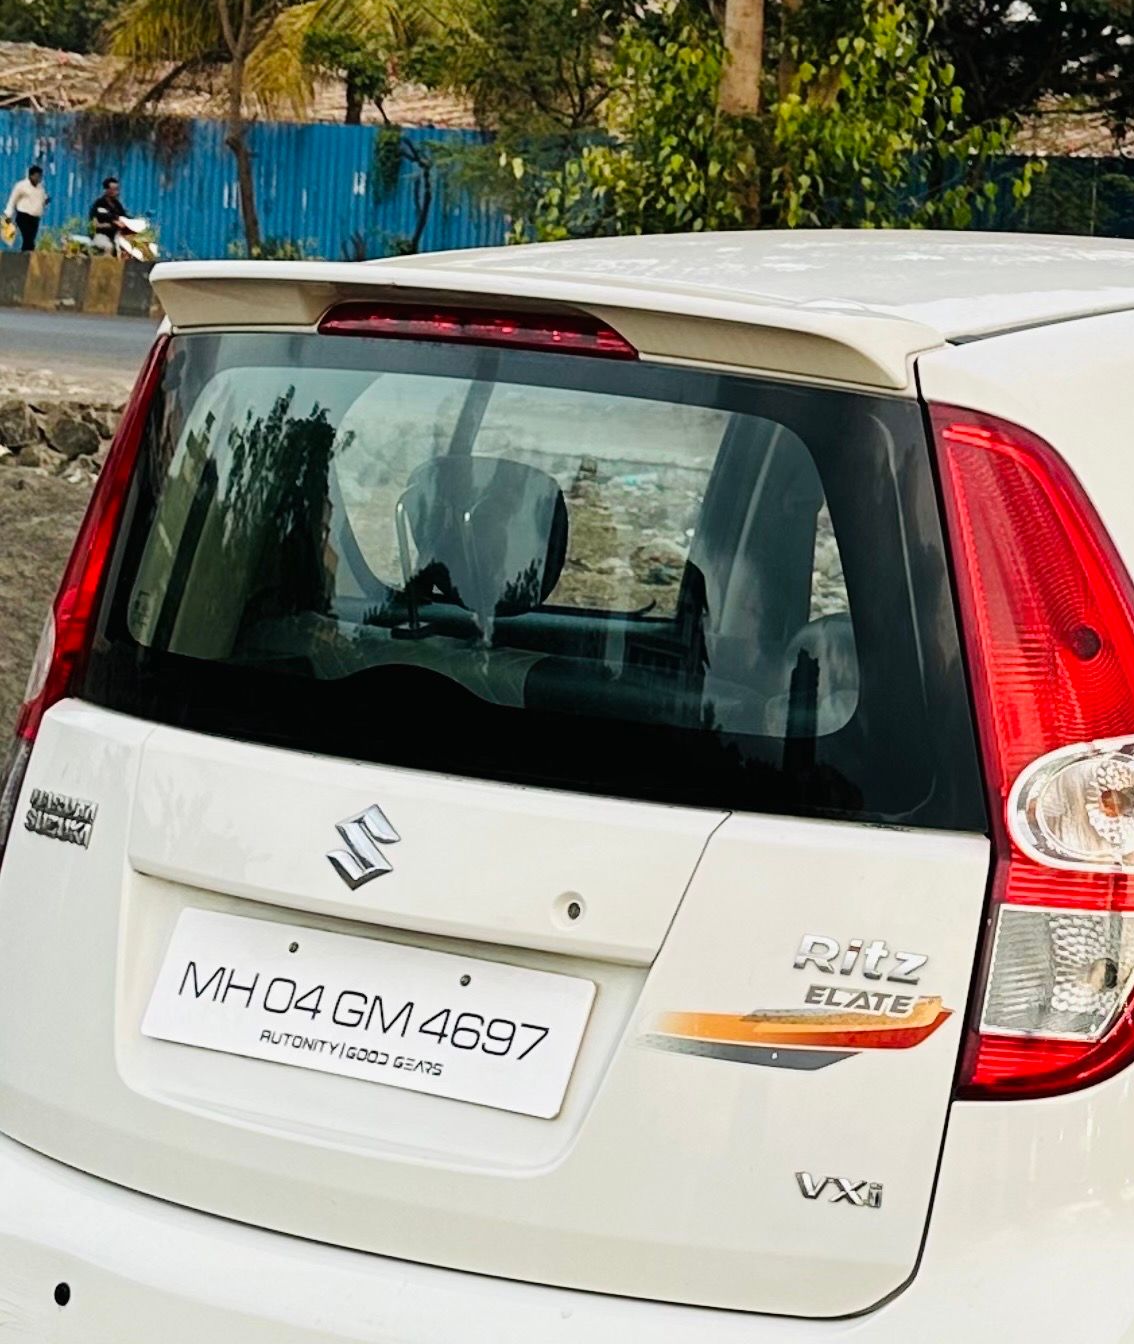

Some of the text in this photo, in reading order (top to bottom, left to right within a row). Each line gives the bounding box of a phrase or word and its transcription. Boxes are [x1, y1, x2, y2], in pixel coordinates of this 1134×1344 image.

[24, 807, 93, 850] SUZUKI
[793, 933, 929, 986] Ritz
[178, 960, 550, 1060] MH 04 GM 4697
[804, 983, 915, 1014] ELATE
[392, 1054, 445, 1077] GEARS
[794, 1170, 884, 1210] VXi
